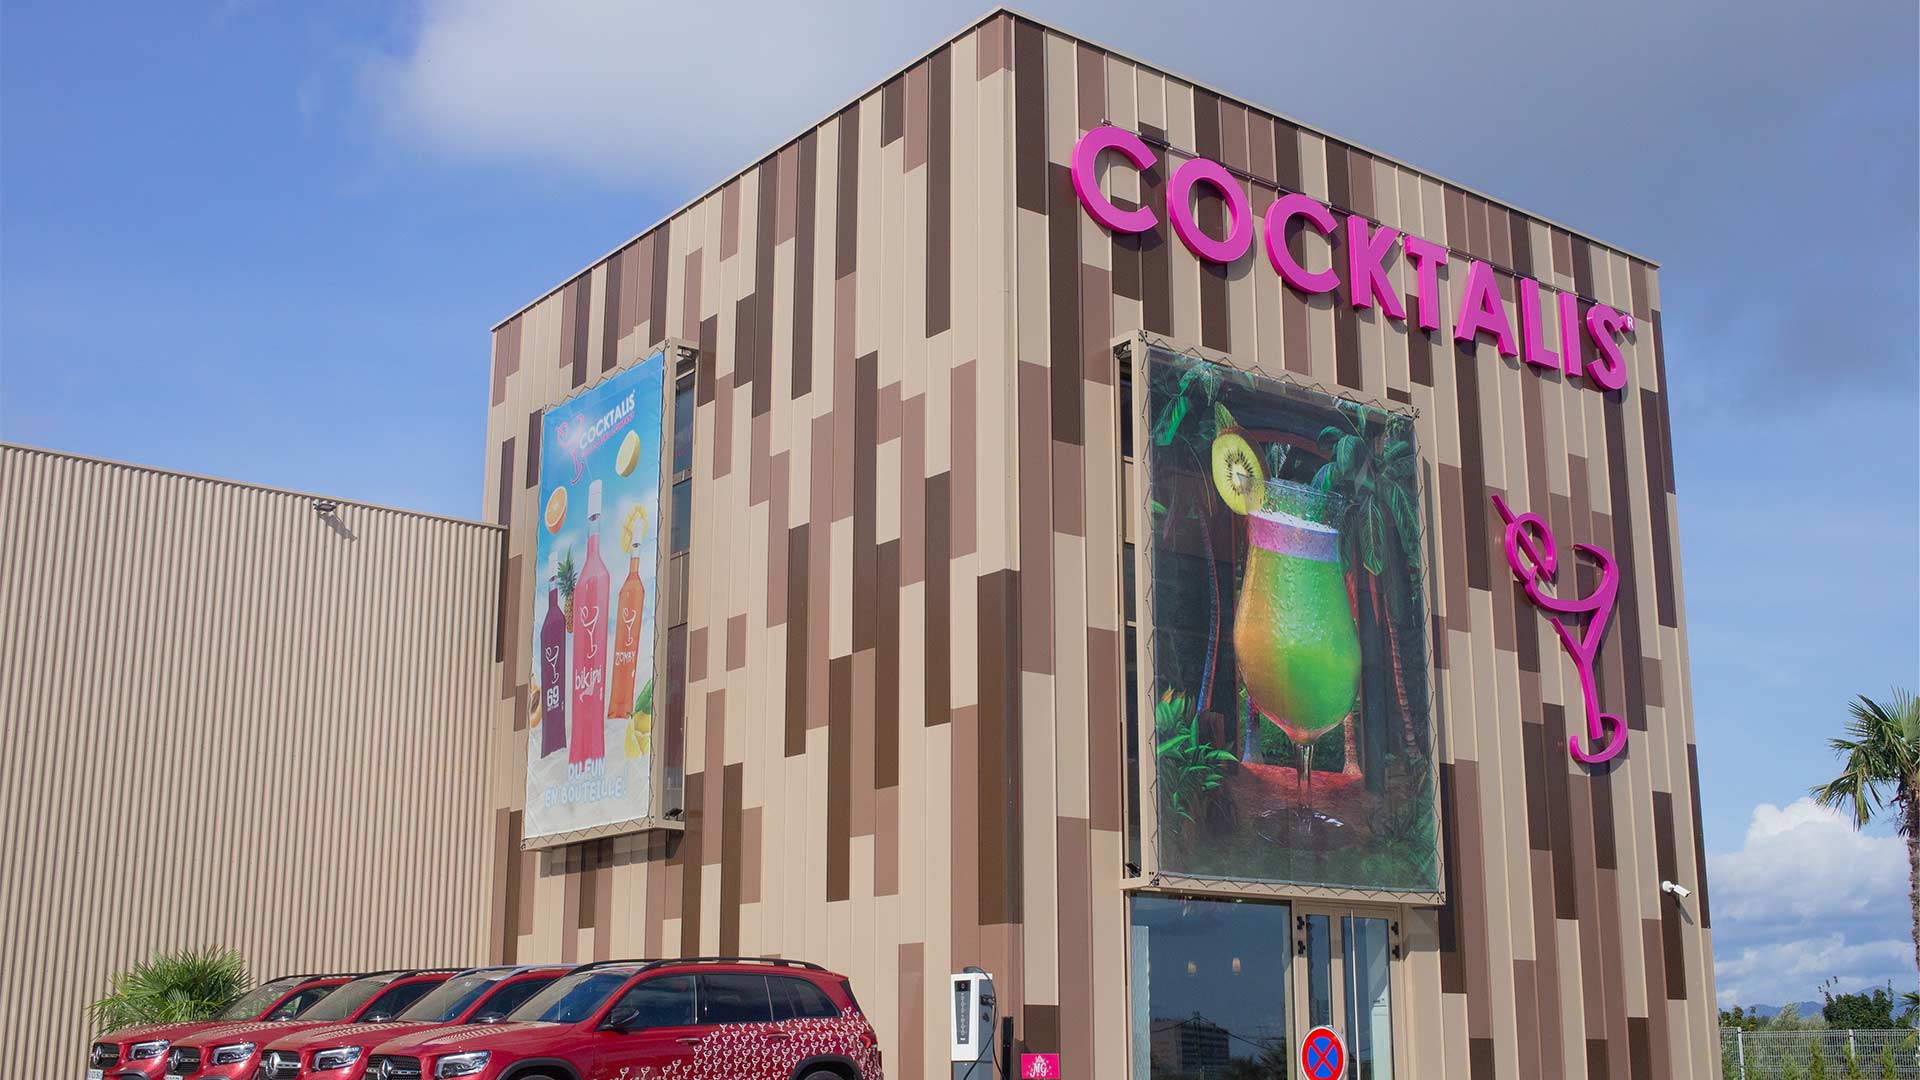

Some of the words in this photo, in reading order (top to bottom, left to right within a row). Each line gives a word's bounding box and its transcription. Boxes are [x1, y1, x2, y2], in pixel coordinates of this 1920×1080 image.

[1072, 126, 1627, 391] COCKTALIS
[580, 393, 635, 449] COCKTALIS
[546, 685, 560, 707] 69
[567, 762, 583, 782] DU
[584, 757, 606, 778] FUN
[544, 785, 559, 808] EN
